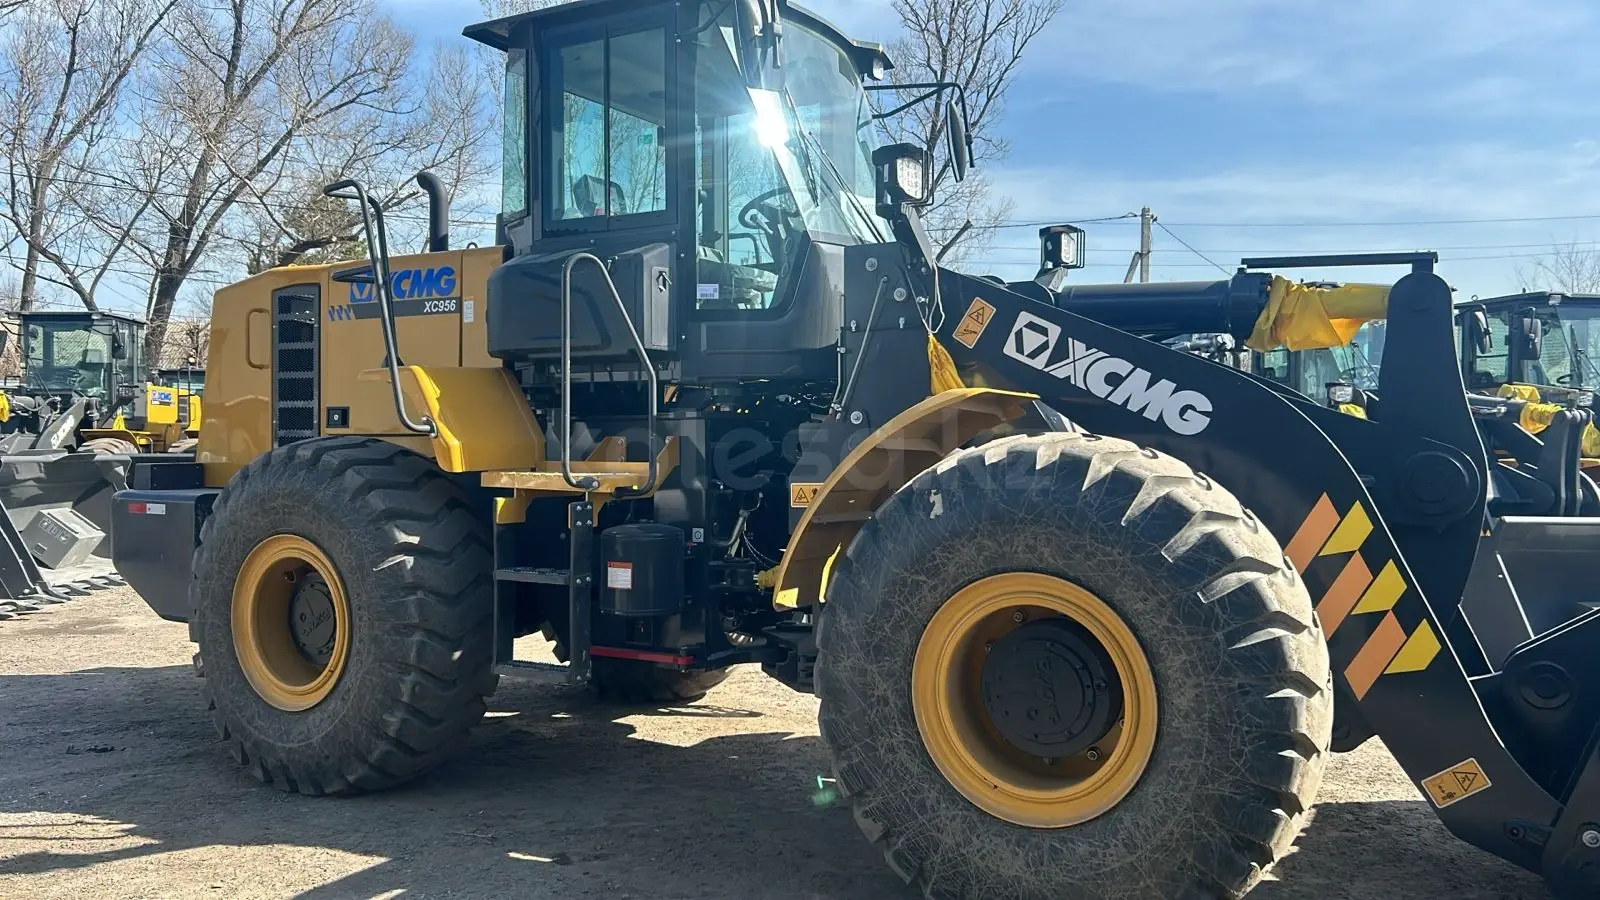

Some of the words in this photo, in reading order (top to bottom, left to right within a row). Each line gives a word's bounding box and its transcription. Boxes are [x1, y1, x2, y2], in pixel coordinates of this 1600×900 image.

[371, 265, 457, 300] CMG
[423, 299, 457, 313] XC956
[1042, 337, 1213, 436] XCMG
